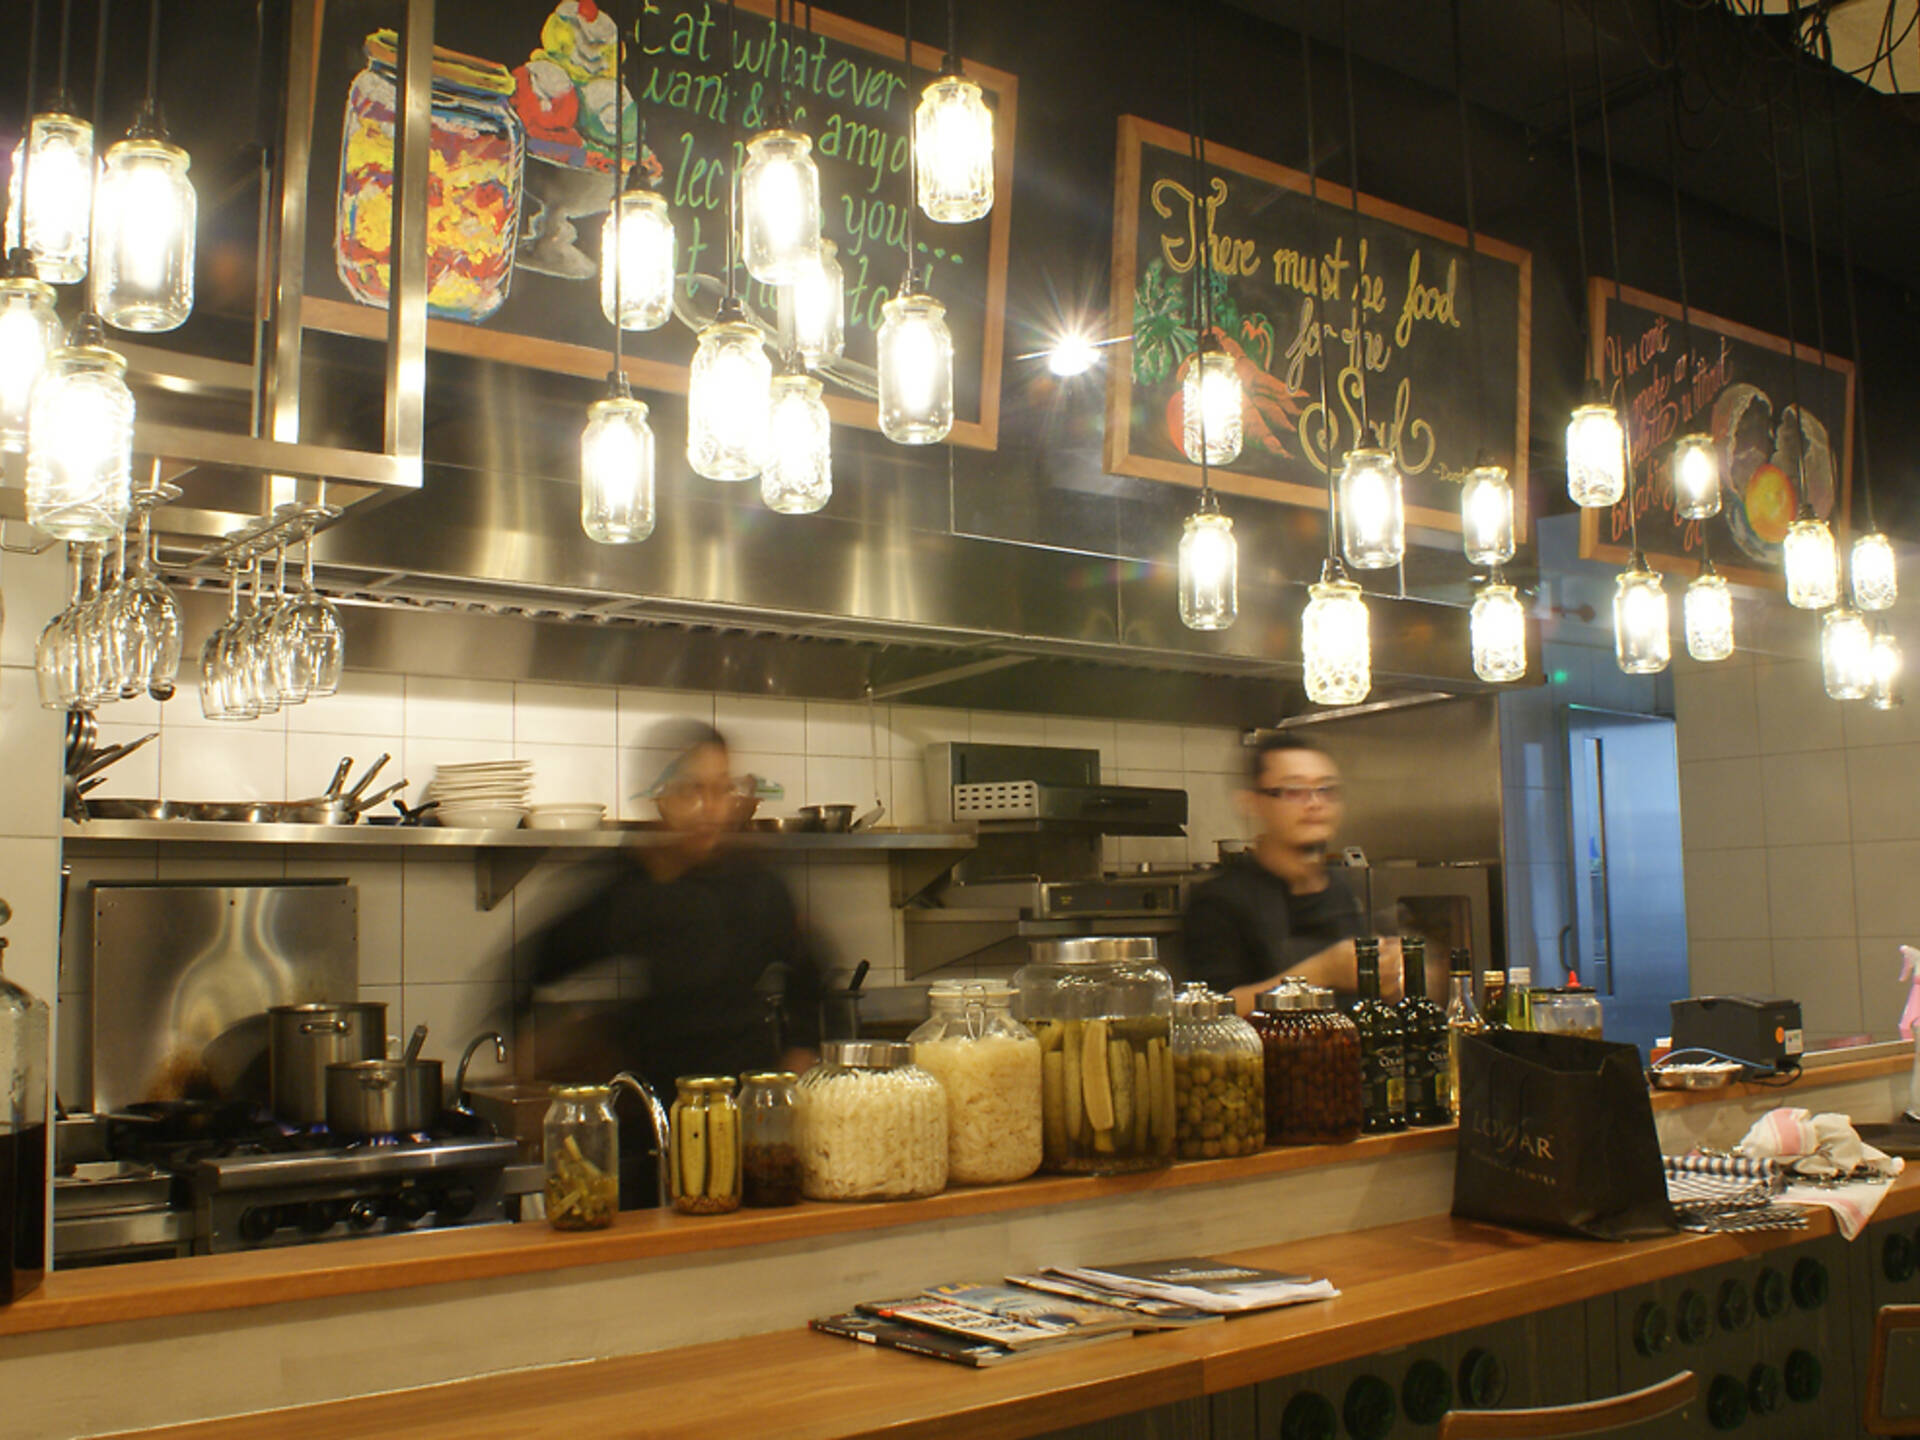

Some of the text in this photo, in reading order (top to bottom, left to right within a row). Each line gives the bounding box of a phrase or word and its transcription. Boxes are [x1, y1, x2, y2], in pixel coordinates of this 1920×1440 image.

[733, 20, 907, 111] whatever
[1273, 236, 1350, 301] must
[1394, 248, 1461, 349] food
